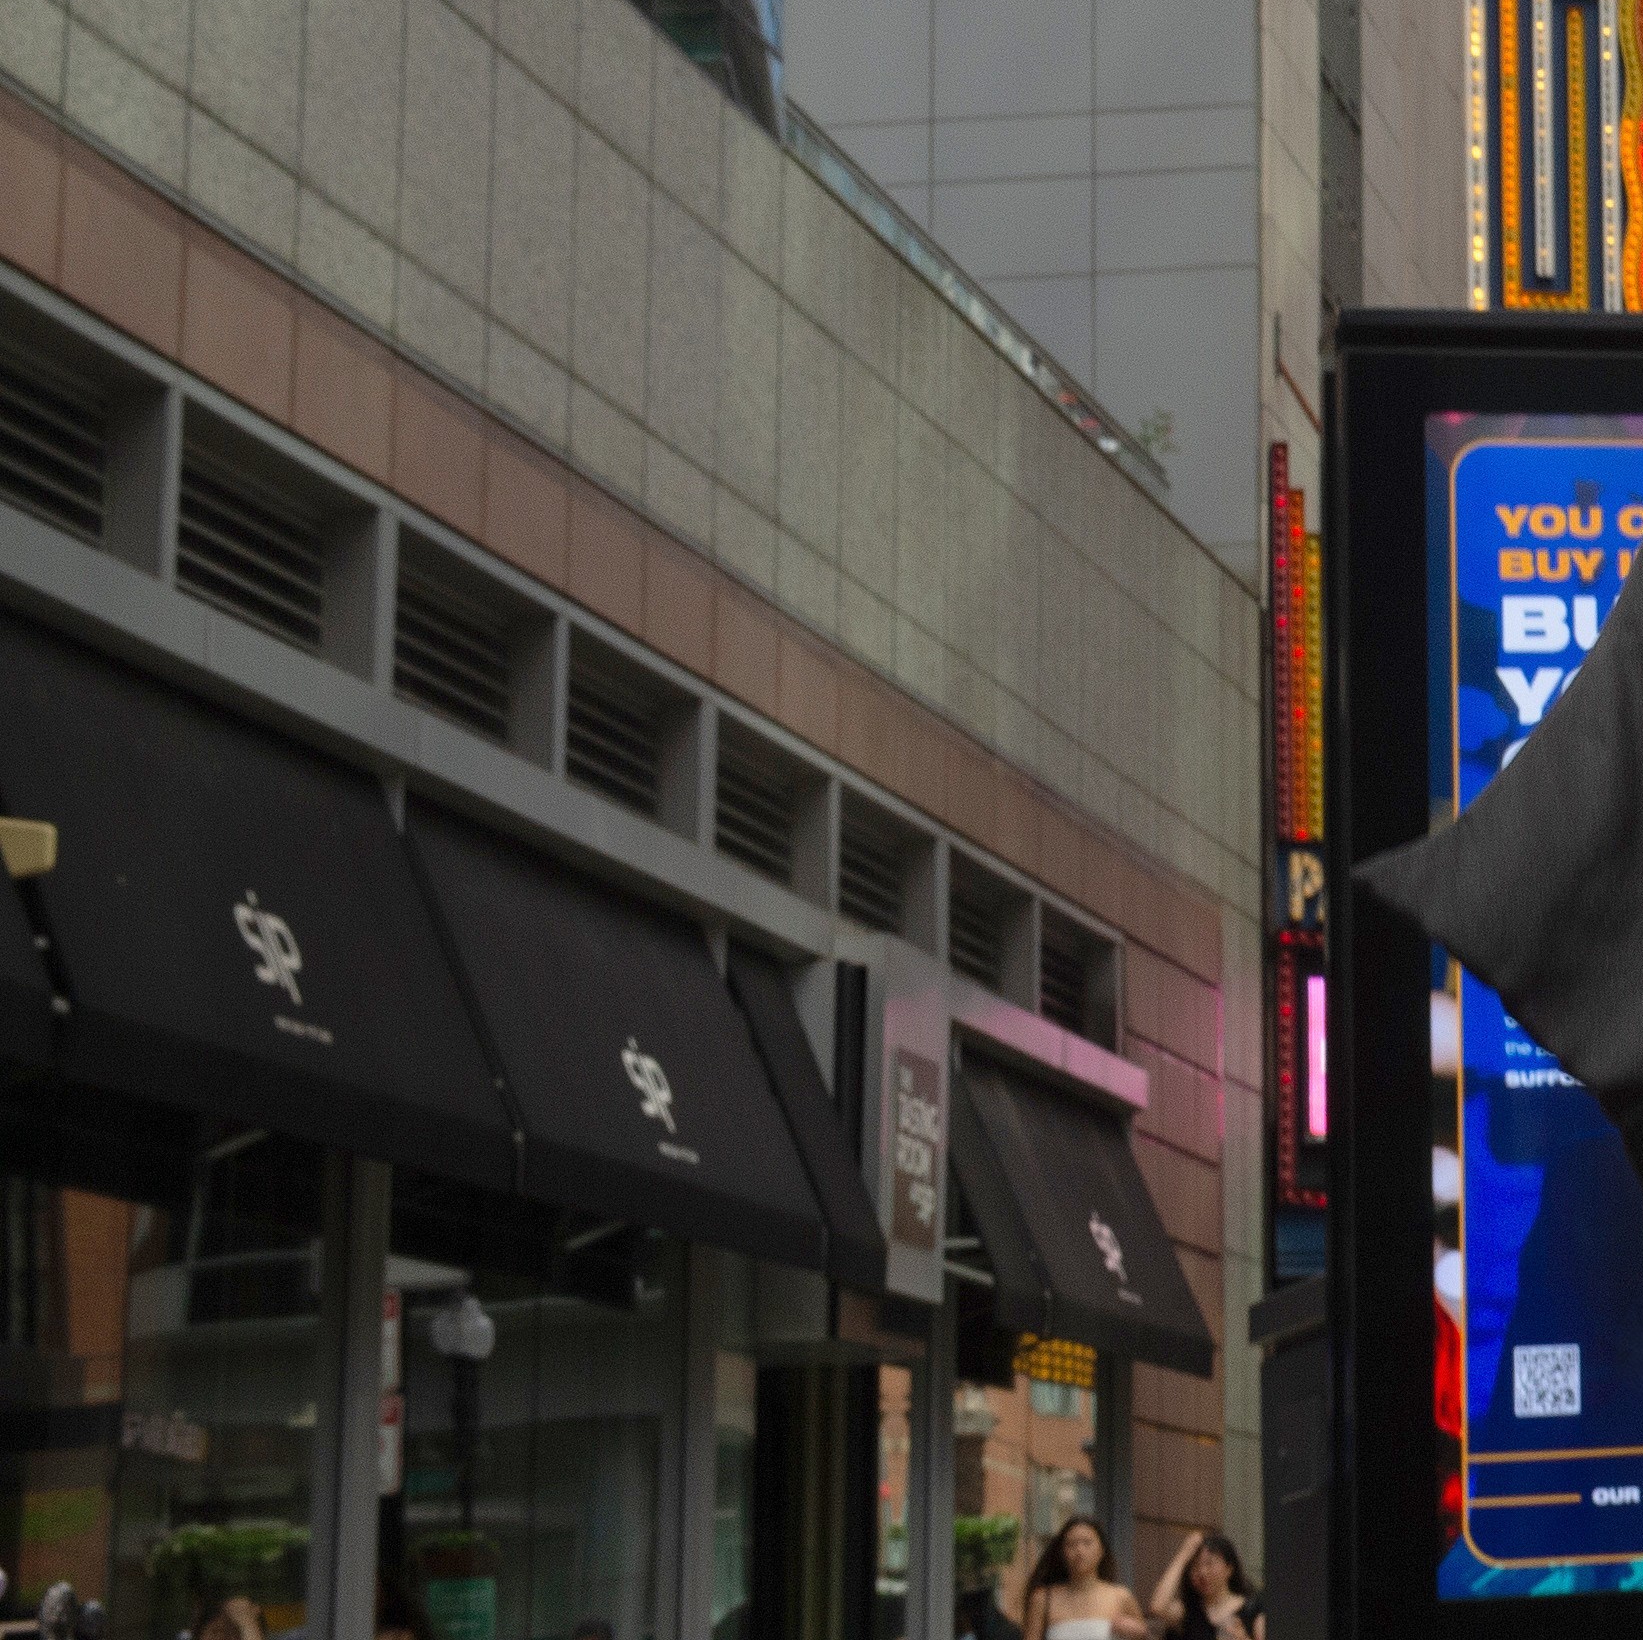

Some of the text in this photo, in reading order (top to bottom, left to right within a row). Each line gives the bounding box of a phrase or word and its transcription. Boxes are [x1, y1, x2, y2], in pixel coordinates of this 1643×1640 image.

[1496, 504, 1604, 539] YOU
[1499, 548, 1604, 582] BUY
[1504, 1068, 1587, 1090] SUFFO
[1592, 1485, 1641, 1506] OUR
